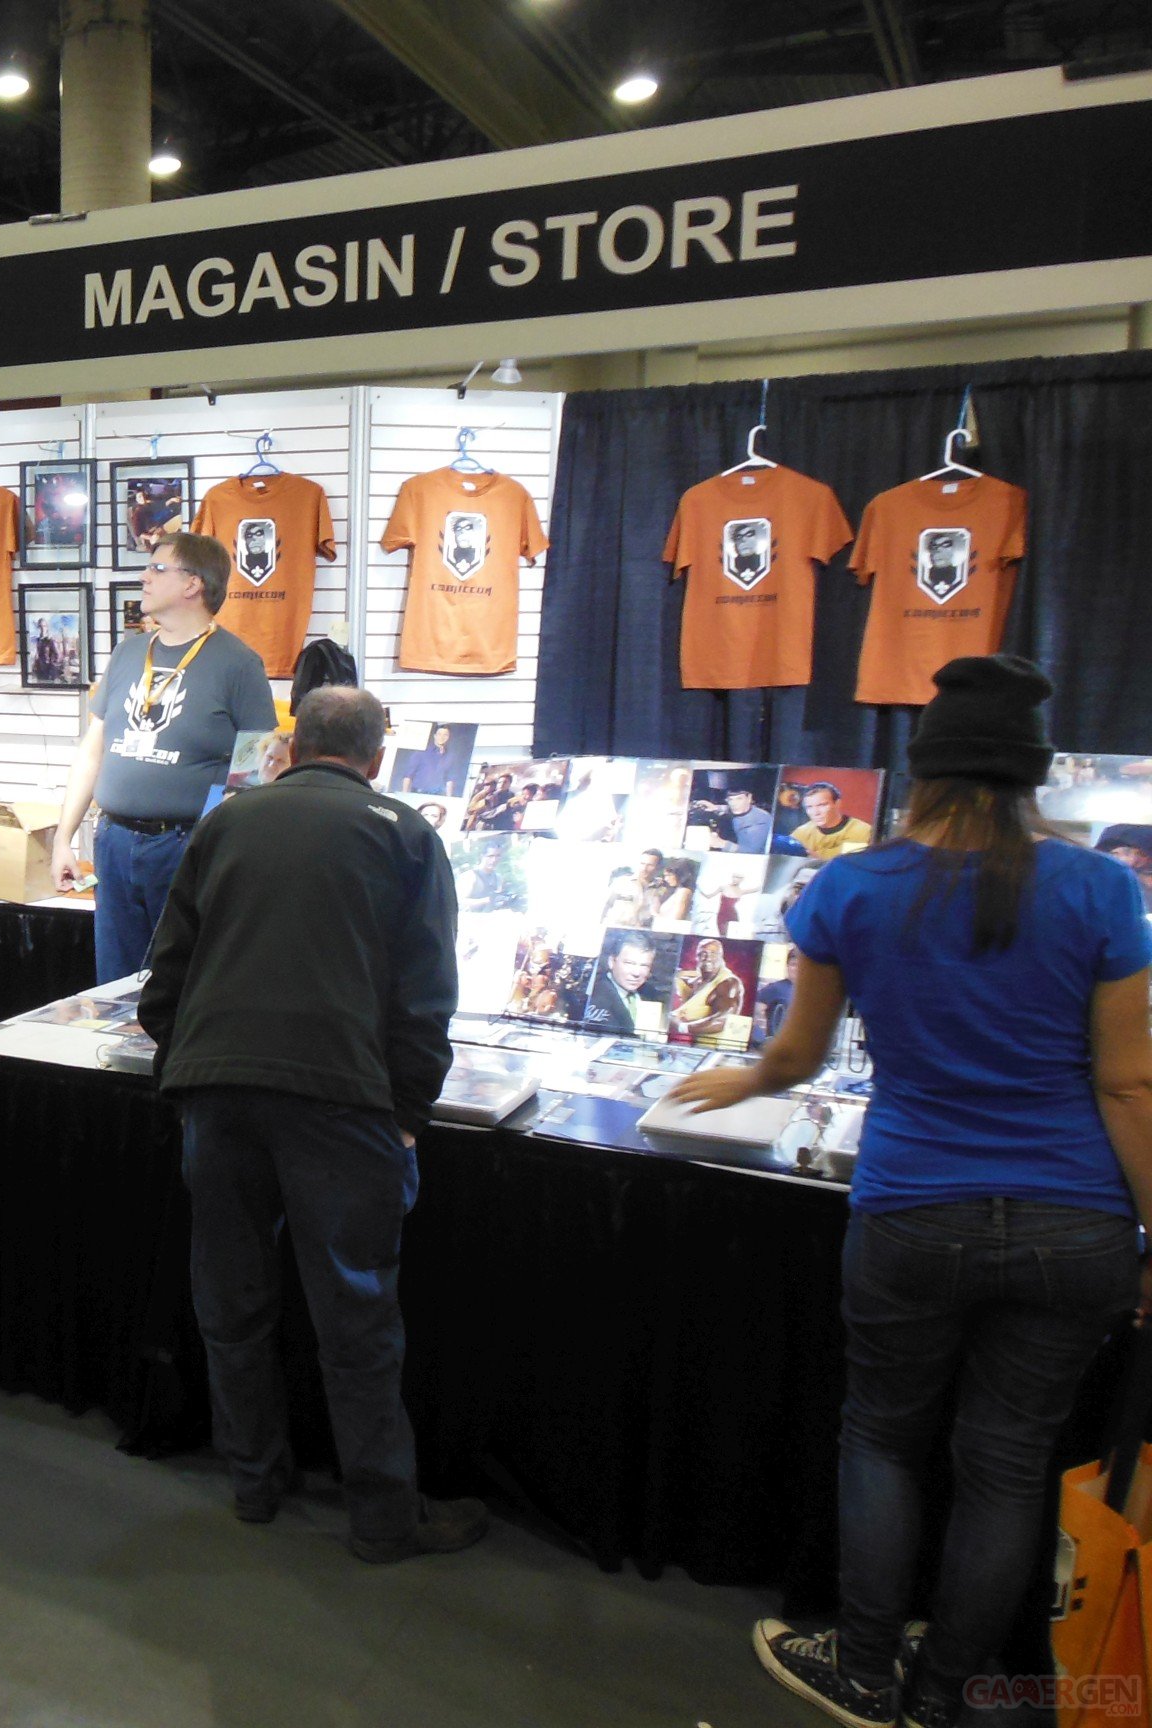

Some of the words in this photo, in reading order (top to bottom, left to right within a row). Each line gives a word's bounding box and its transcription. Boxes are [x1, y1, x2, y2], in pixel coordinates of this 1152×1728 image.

[84, 234, 416, 329] MAGASIN
[439, 226, 466, 294] /
[488, 184, 799, 287] STORE
